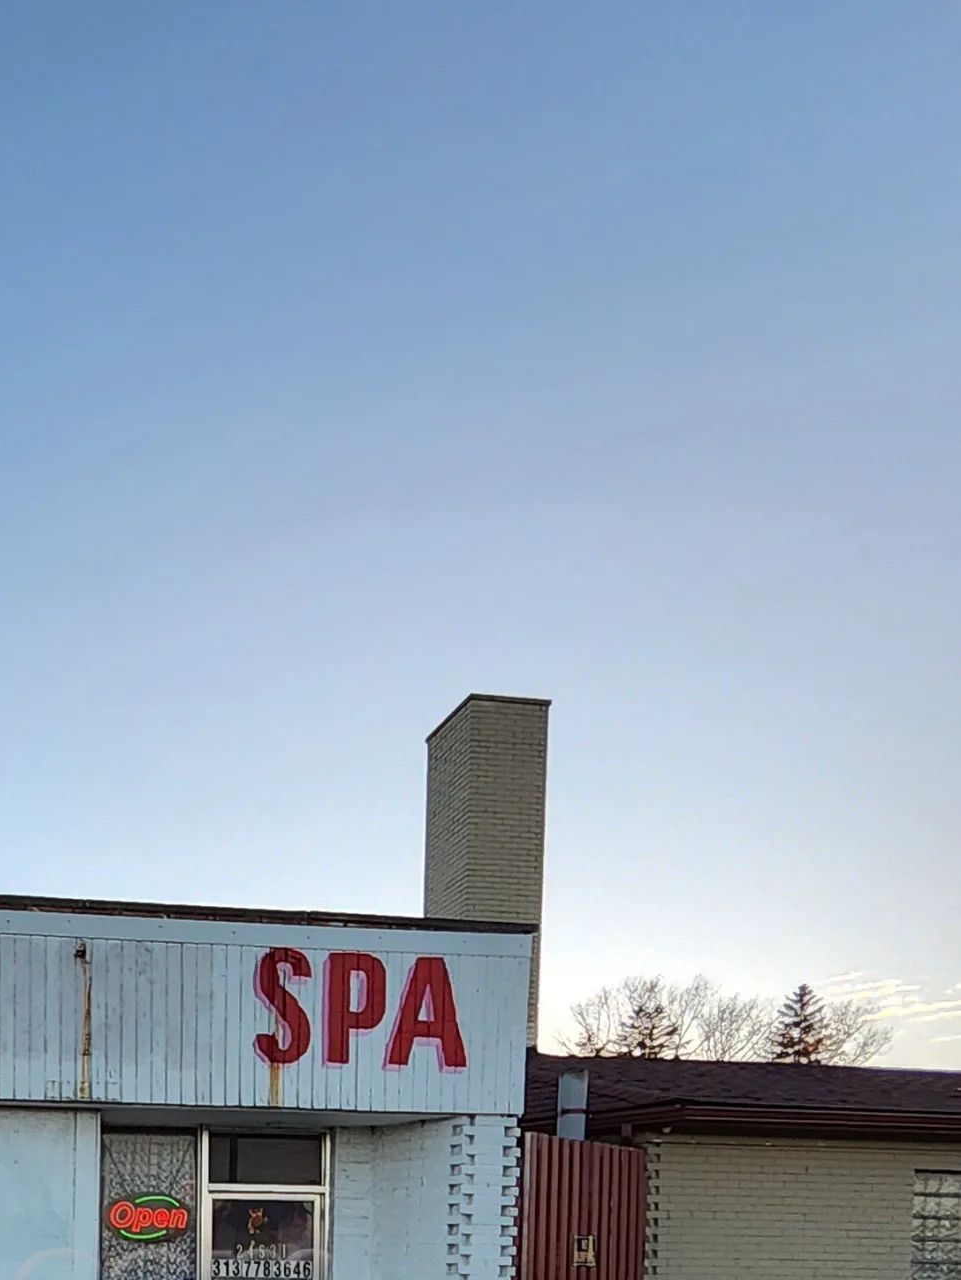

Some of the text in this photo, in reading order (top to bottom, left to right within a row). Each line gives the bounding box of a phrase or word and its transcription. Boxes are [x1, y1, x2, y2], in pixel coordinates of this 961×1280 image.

[252, 946, 468, 1074] SPA
[109, 1200, 189, 1233] Open
[212, 1260, 312, 1278] 3137783646
